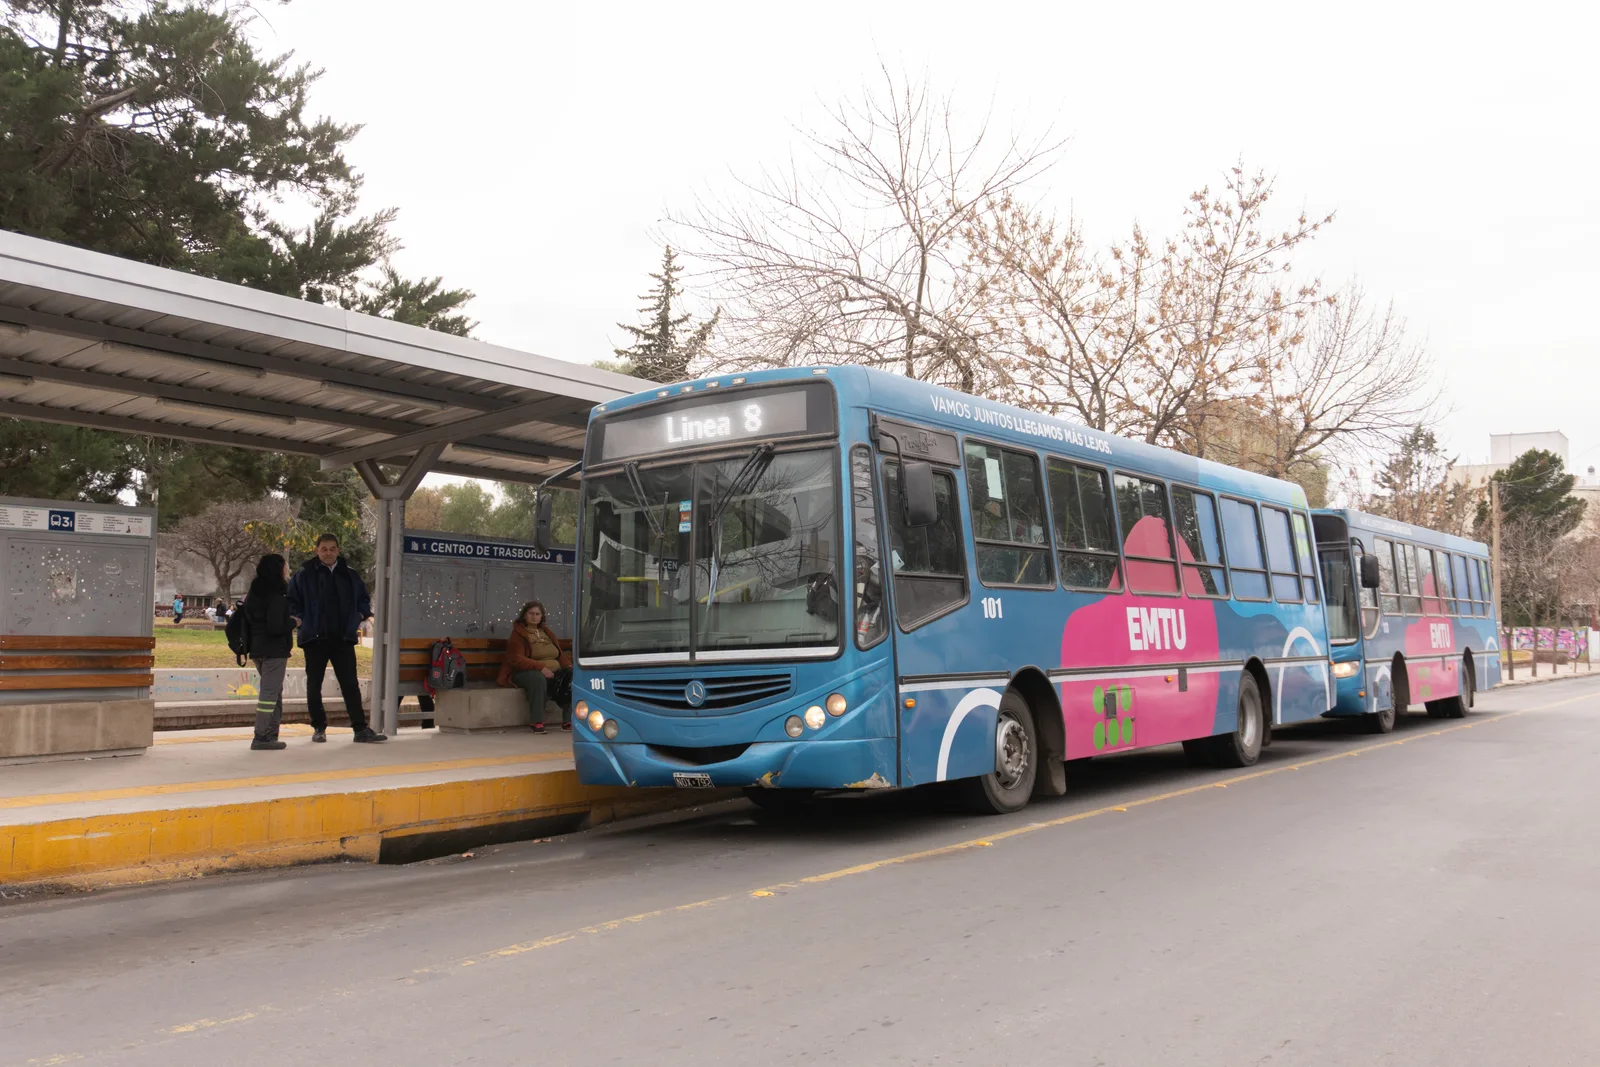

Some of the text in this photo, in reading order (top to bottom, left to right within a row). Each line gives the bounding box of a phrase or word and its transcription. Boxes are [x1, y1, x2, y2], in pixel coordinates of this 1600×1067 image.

[743, 404, 762, 432] 8
[930, 395, 1112, 455] VAMOS JUNTOS LLEGAMOS MÁS LEJOS.
[431, 542, 474, 554] CENTRO
[476, 546, 489, 556] DE
[662, 561, 678, 570] CEN
[981, 597, 1003, 619] 101
[1126, 606, 1187, 651] EMTU
[1429, 623, 1451, 649] EMTU
[589, 677, 605, 691] 101
